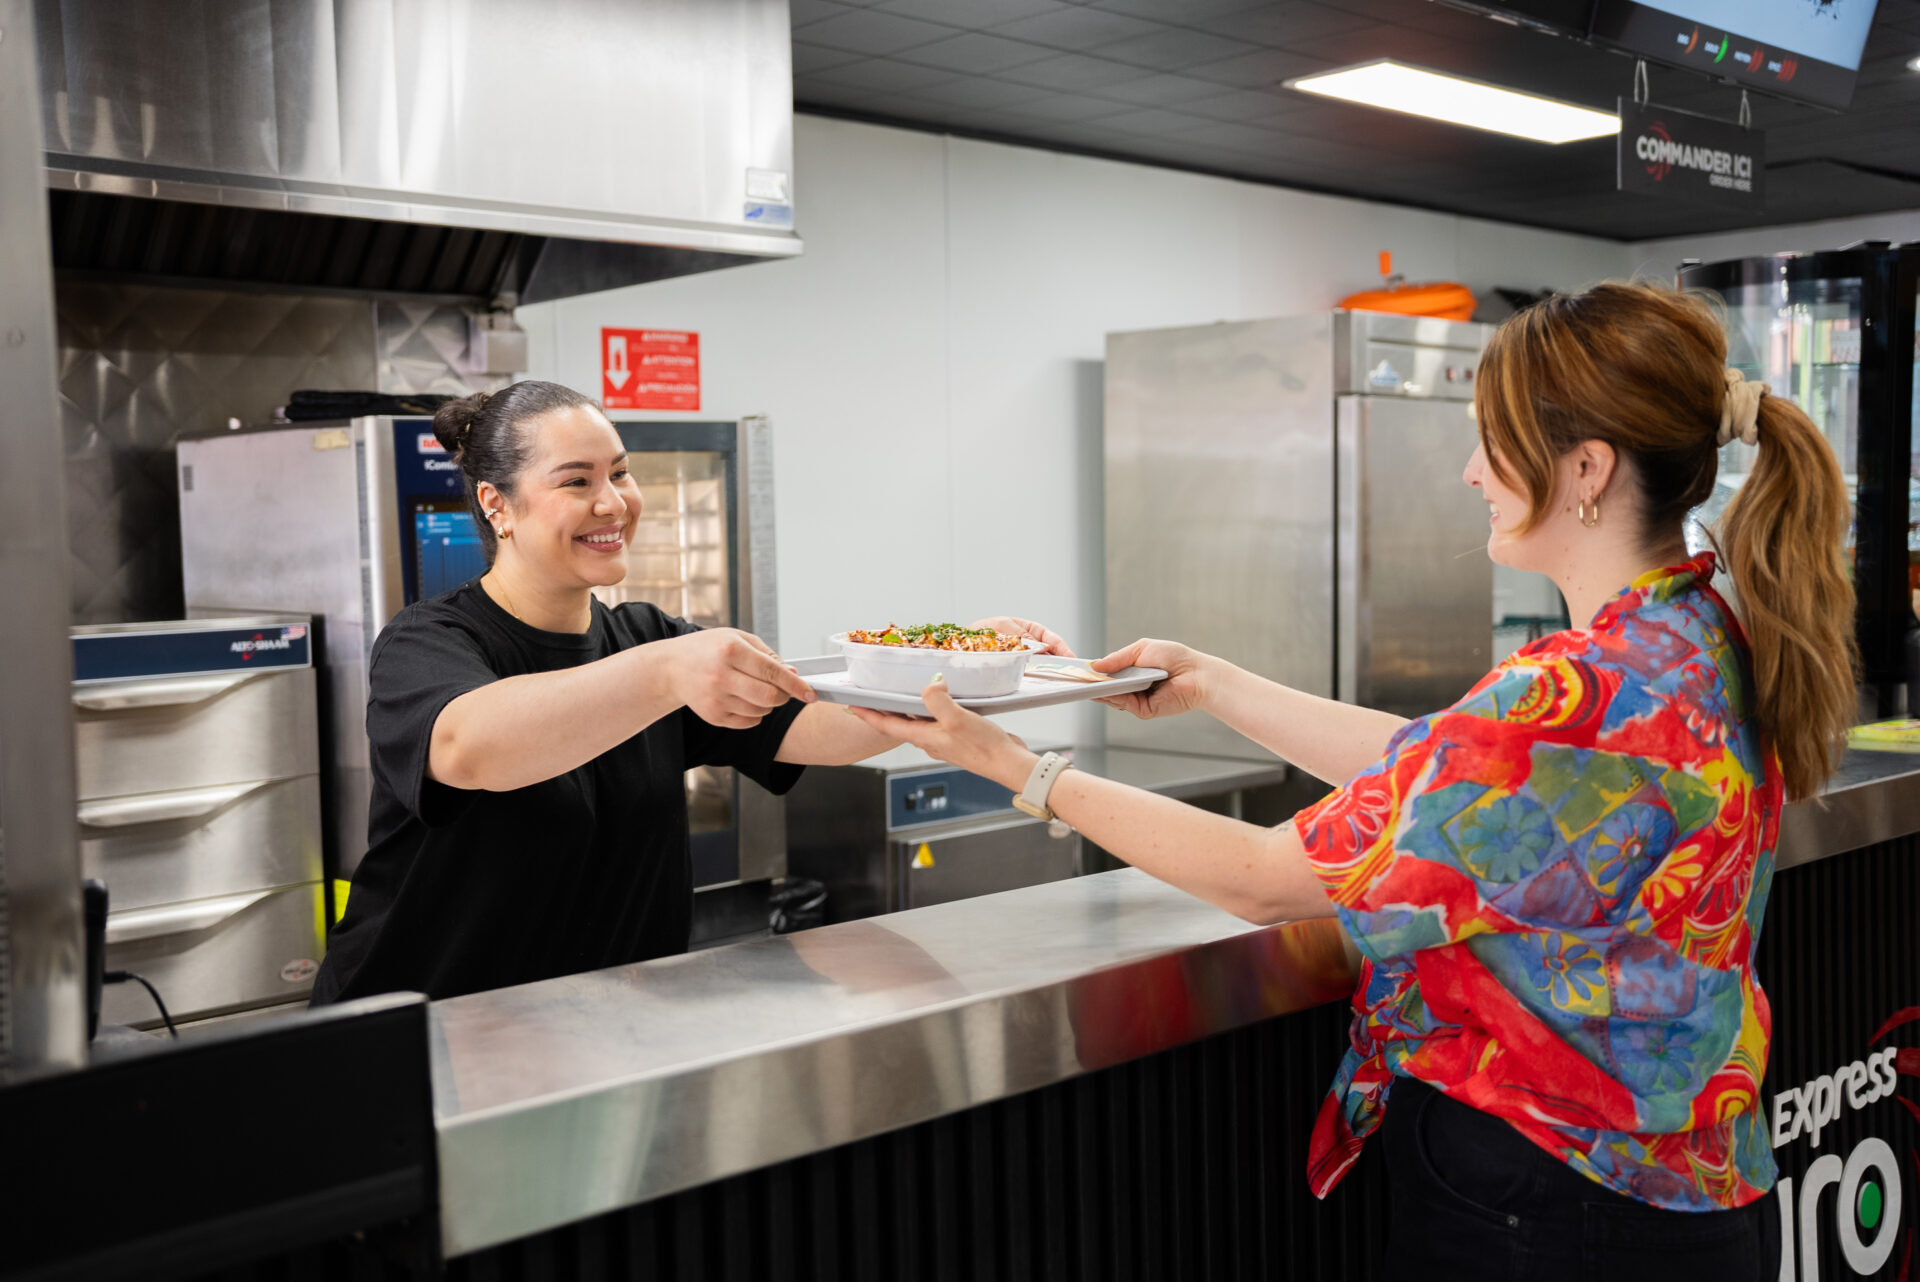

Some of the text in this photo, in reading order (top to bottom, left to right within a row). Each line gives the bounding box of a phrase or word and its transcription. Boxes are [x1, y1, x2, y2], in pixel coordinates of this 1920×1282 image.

[1636, 135, 1752, 178] COMMANDER ICI
[1709, 173, 1733, 188] ORDER
[1771, 1046, 1898, 1149] Express
